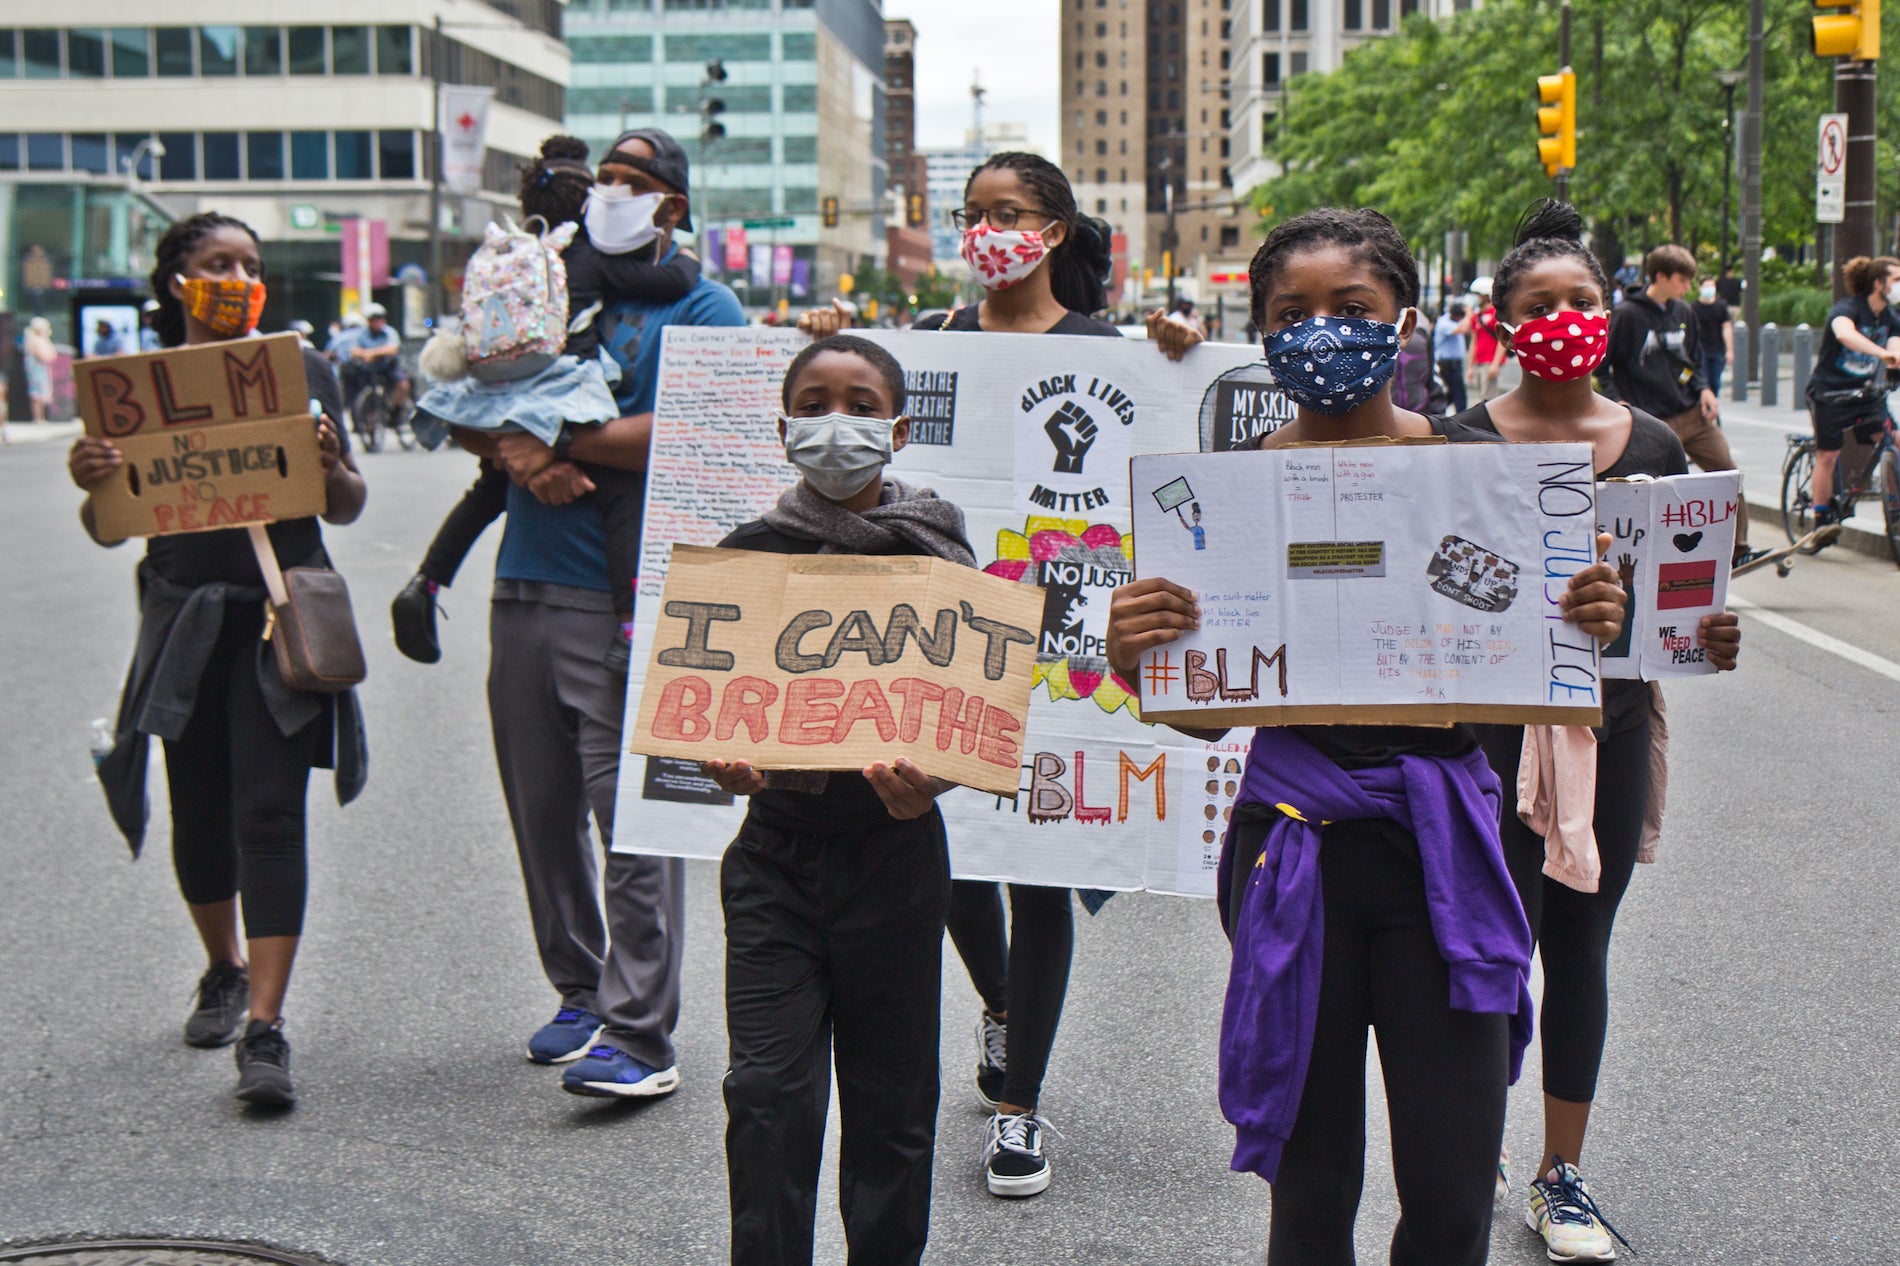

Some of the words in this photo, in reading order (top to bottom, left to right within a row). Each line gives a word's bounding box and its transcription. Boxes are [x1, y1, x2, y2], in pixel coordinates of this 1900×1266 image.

[90, 343, 279, 438] BLM
[905, 370, 953, 392] REATHE
[902, 395, 952, 418] REATHE
[1021, 374, 1076, 413] BLACK
[1087, 377, 1134, 426] LIVES
[1233, 389, 1256, 416] MY
[1259, 391, 1299, 419] SKIN
[909, 420, 950, 443] EATHE
[1230, 416, 1247, 443] IS
[173, 430, 207, 452] NO
[147, 444, 276, 485] JUSTICE
[1286, 460, 1303, 471] Black
[1361, 472, 1375, 480] gun
[181, 482, 217, 502] NO
[1029, 484, 1110, 512] MATTER
[1340, 492, 1384, 501] PROTESTER
[1537, 462, 1593, 517] NO
[154, 493, 273, 532] PEACE
[1660, 499, 1737, 528] #BLM
[1044, 561, 1080, 586] NO
[1244, 591, 1271, 601] matter
[1463, 594, 1492, 611] SHOOT
[1218, 608, 1241, 616] black
[1543, 530, 1596, 704] JUICE
[1371, 621, 1411, 635] JUDGE
[1420, 625, 1427, 635] A
[1463, 624, 1482, 635] NOT
[1490, 624, 1502, 635] BY
[1659, 626, 1676, 638] WE
[657, 600, 742, 672] I
[774, 600, 1036, 681] CAN'T
[1043, 630, 1079, 655] NO
[1373, 638, 1397, 649] THE
[1441, 637, 1454, 648] OF
[1457, 638, 1481, 650] HIS
[1663, 636, 1690, 651] NEED
[1377, 653, 1395, 665] BUT
[1399, 653, 1409, 665] BY
[1418, 653, 1436, 665] THE
[1444, 654, 1485, 664] CONTENT
[1490, 654, 1509, 664] OF
[1672, 648, 1705, 664] PEACE
[1144, 643, 1288, 705] #BLM
[1379, 668, 1400, 678] HIS
[651, 676, 1021, 769] BREATHE
[1205, 743, 1239, 752] KILLED
